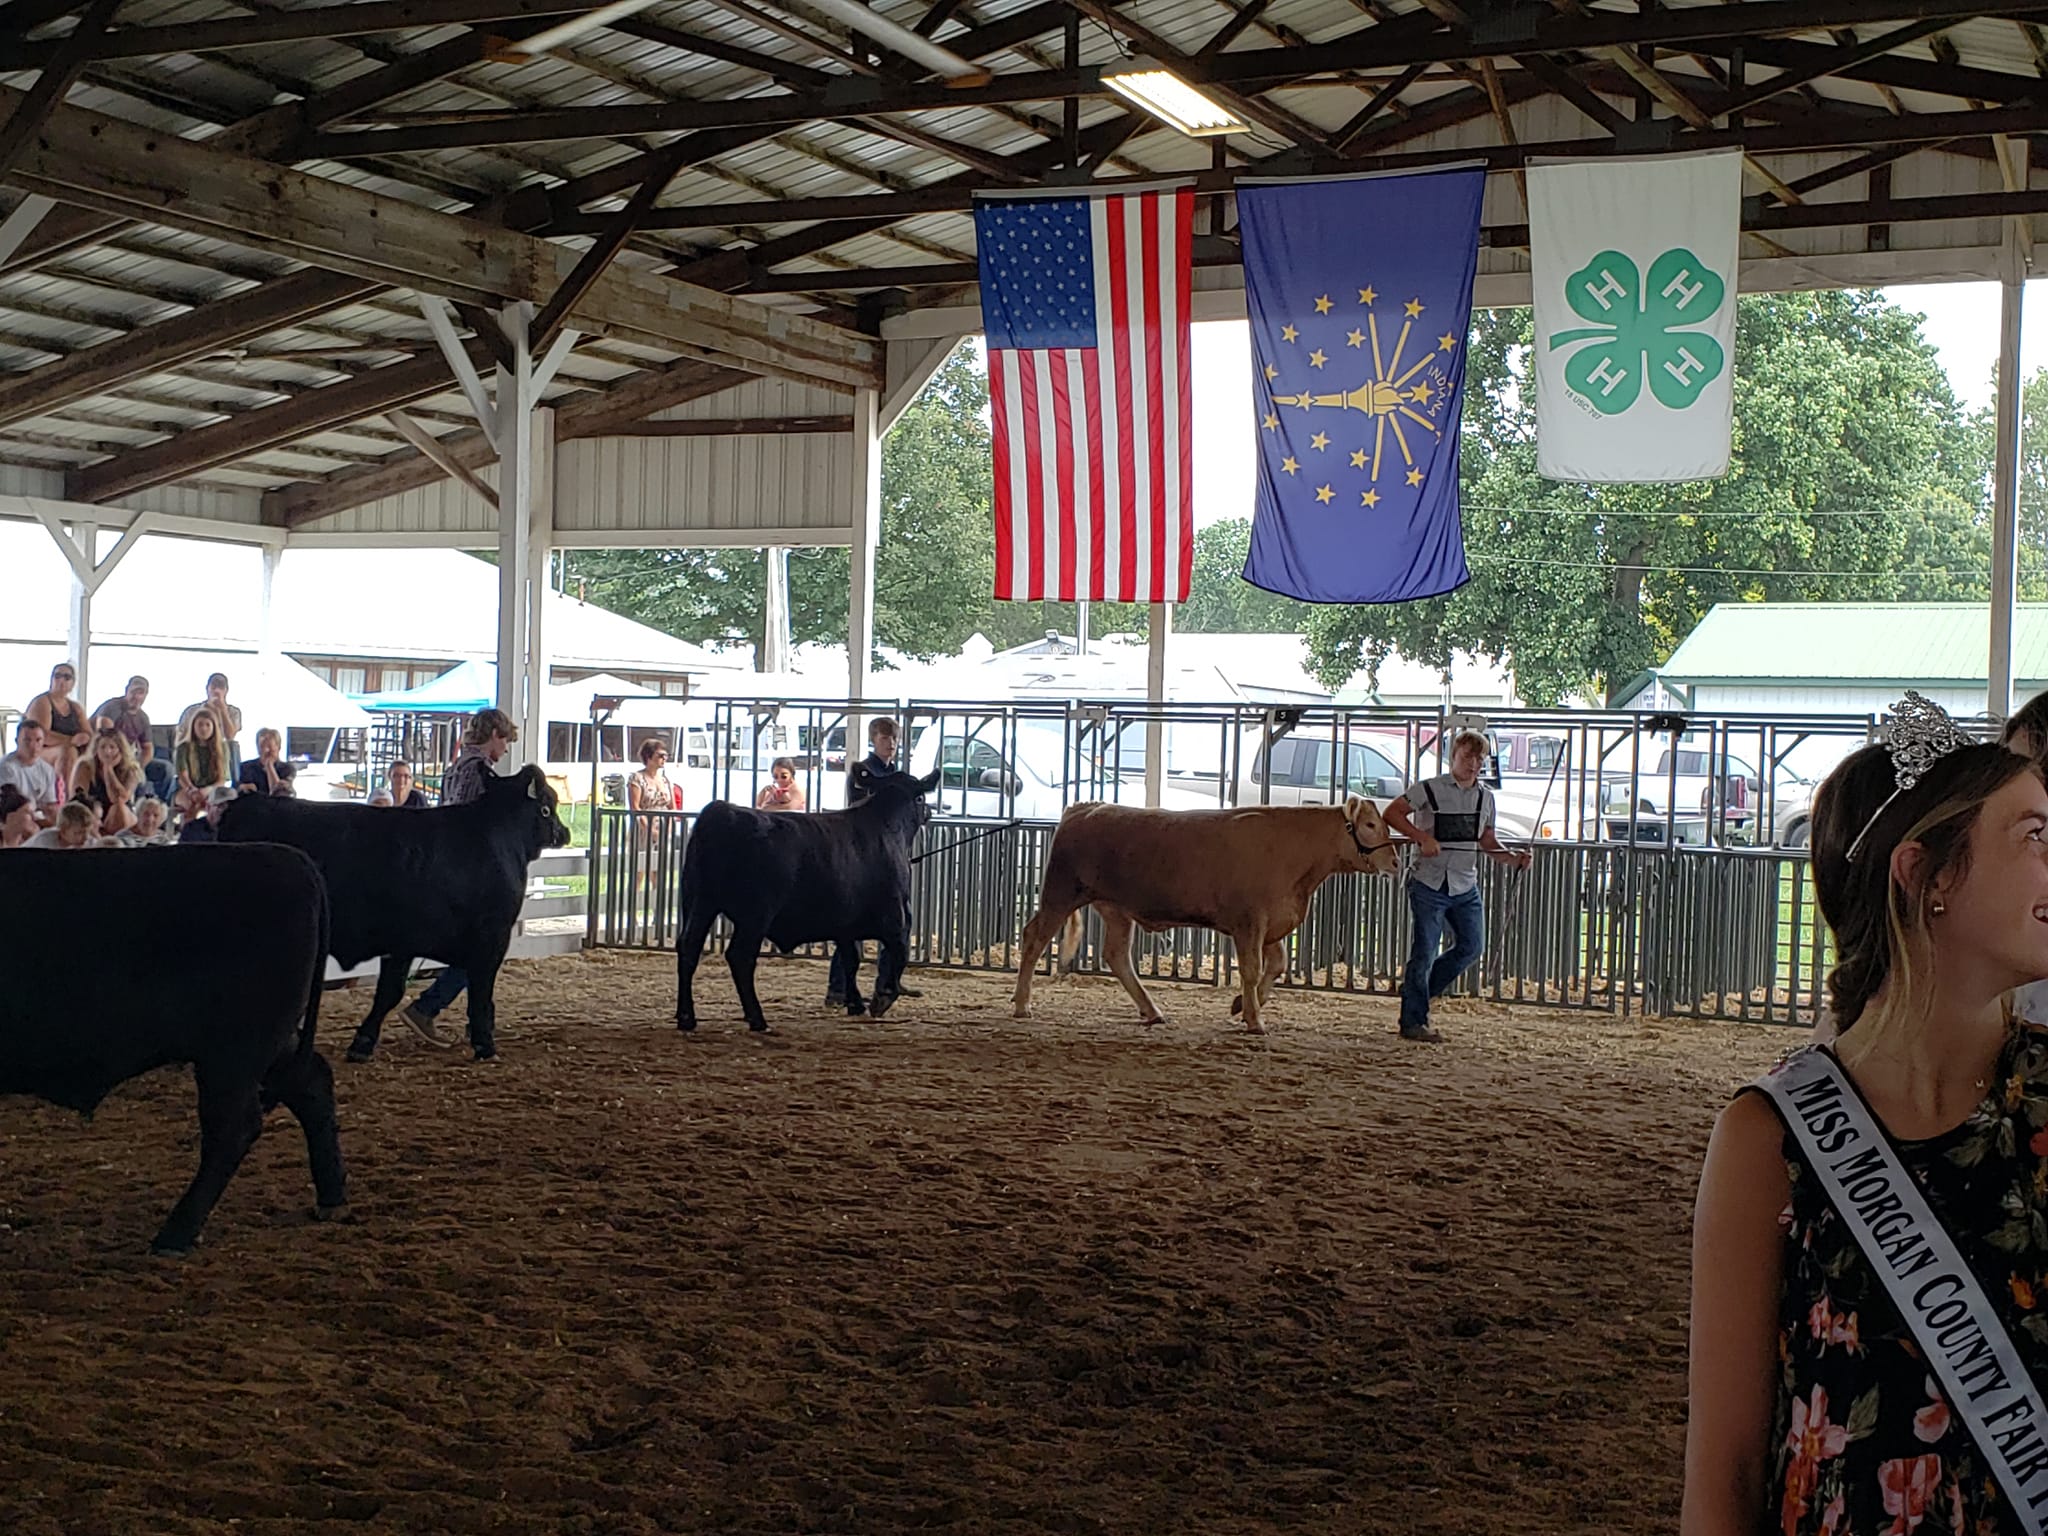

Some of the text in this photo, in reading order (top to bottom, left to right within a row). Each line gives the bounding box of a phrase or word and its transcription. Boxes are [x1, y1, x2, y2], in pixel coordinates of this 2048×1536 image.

[1585, 269, 1627, 311] H
[1661, 268, 1704, 311] H
[1586, 356, 1628, 397] H
[1663, 346, 1705, 387] H
[1427, 365, 1446, 417] INDIANA
[1573, 396, 1590, 411] USC
[1785, 1075, 2048, 1487] MISS MORGAN COUNTY FAIR
